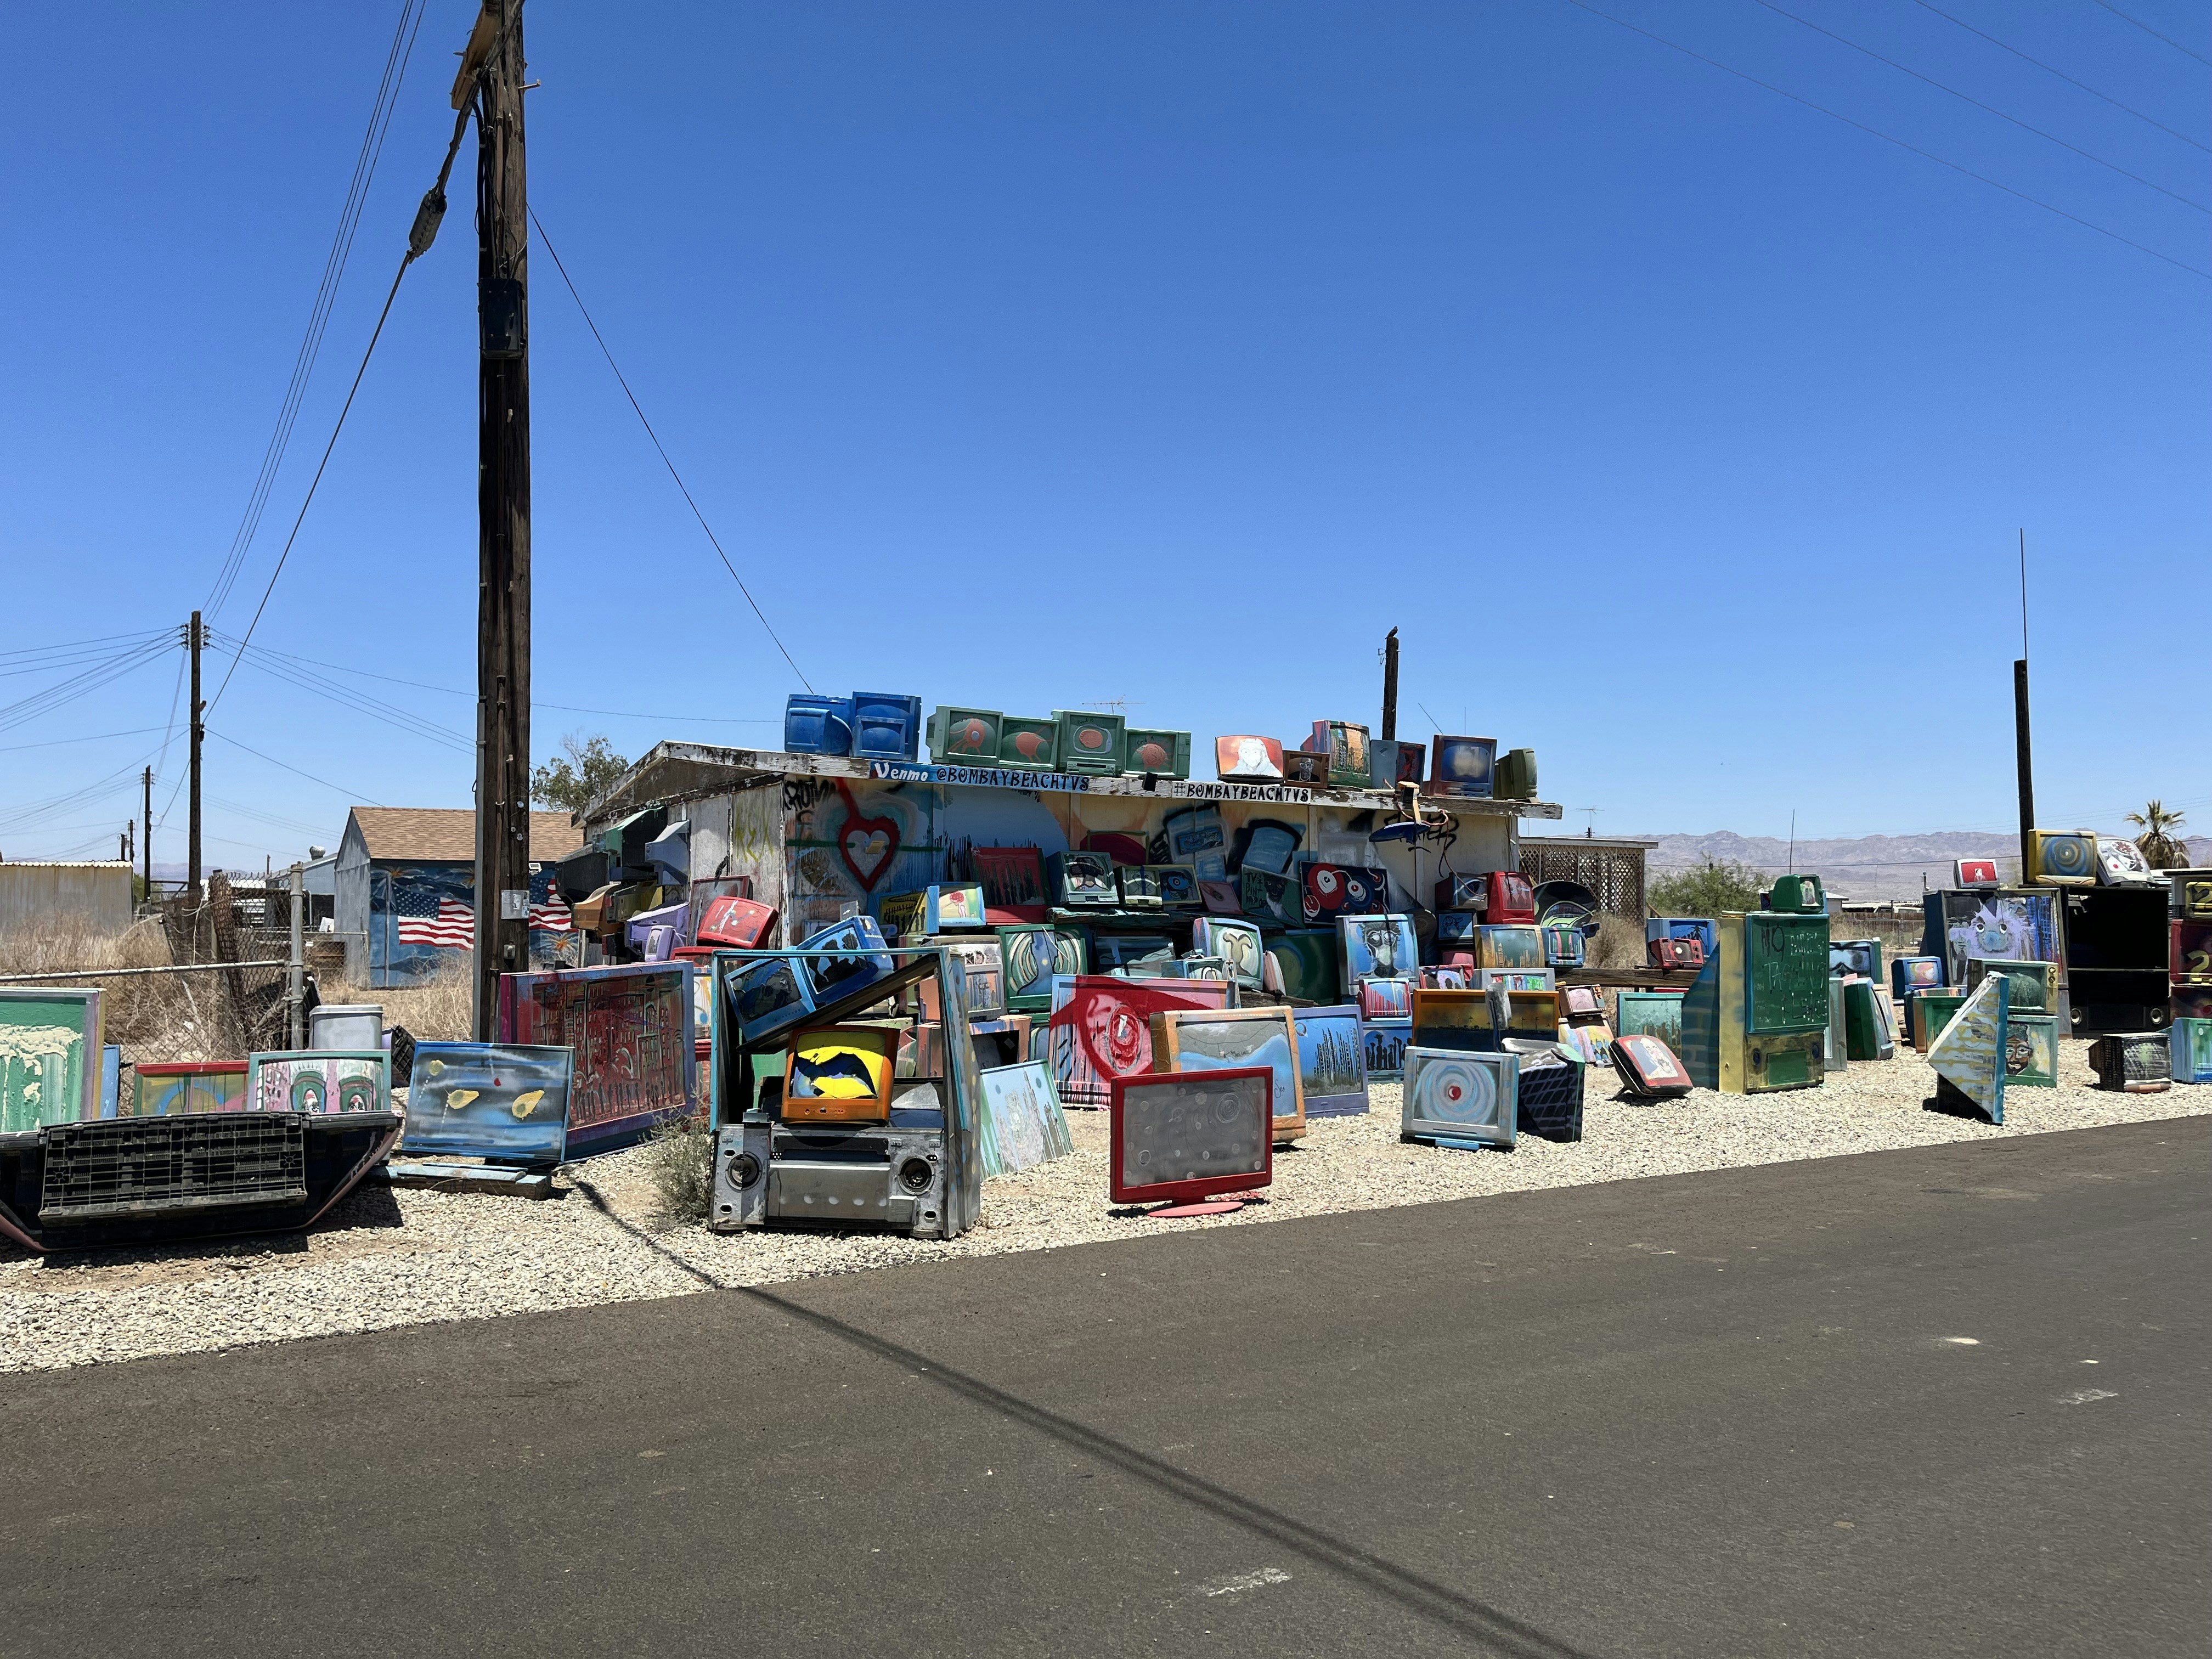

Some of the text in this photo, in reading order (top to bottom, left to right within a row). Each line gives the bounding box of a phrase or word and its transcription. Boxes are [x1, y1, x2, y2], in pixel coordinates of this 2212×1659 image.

[874, 762, 1090, 792] Venmo @BOMBAYBEACHTVS
[1174, 783, 1308, 802] #BOMBAYBEACHTVS
